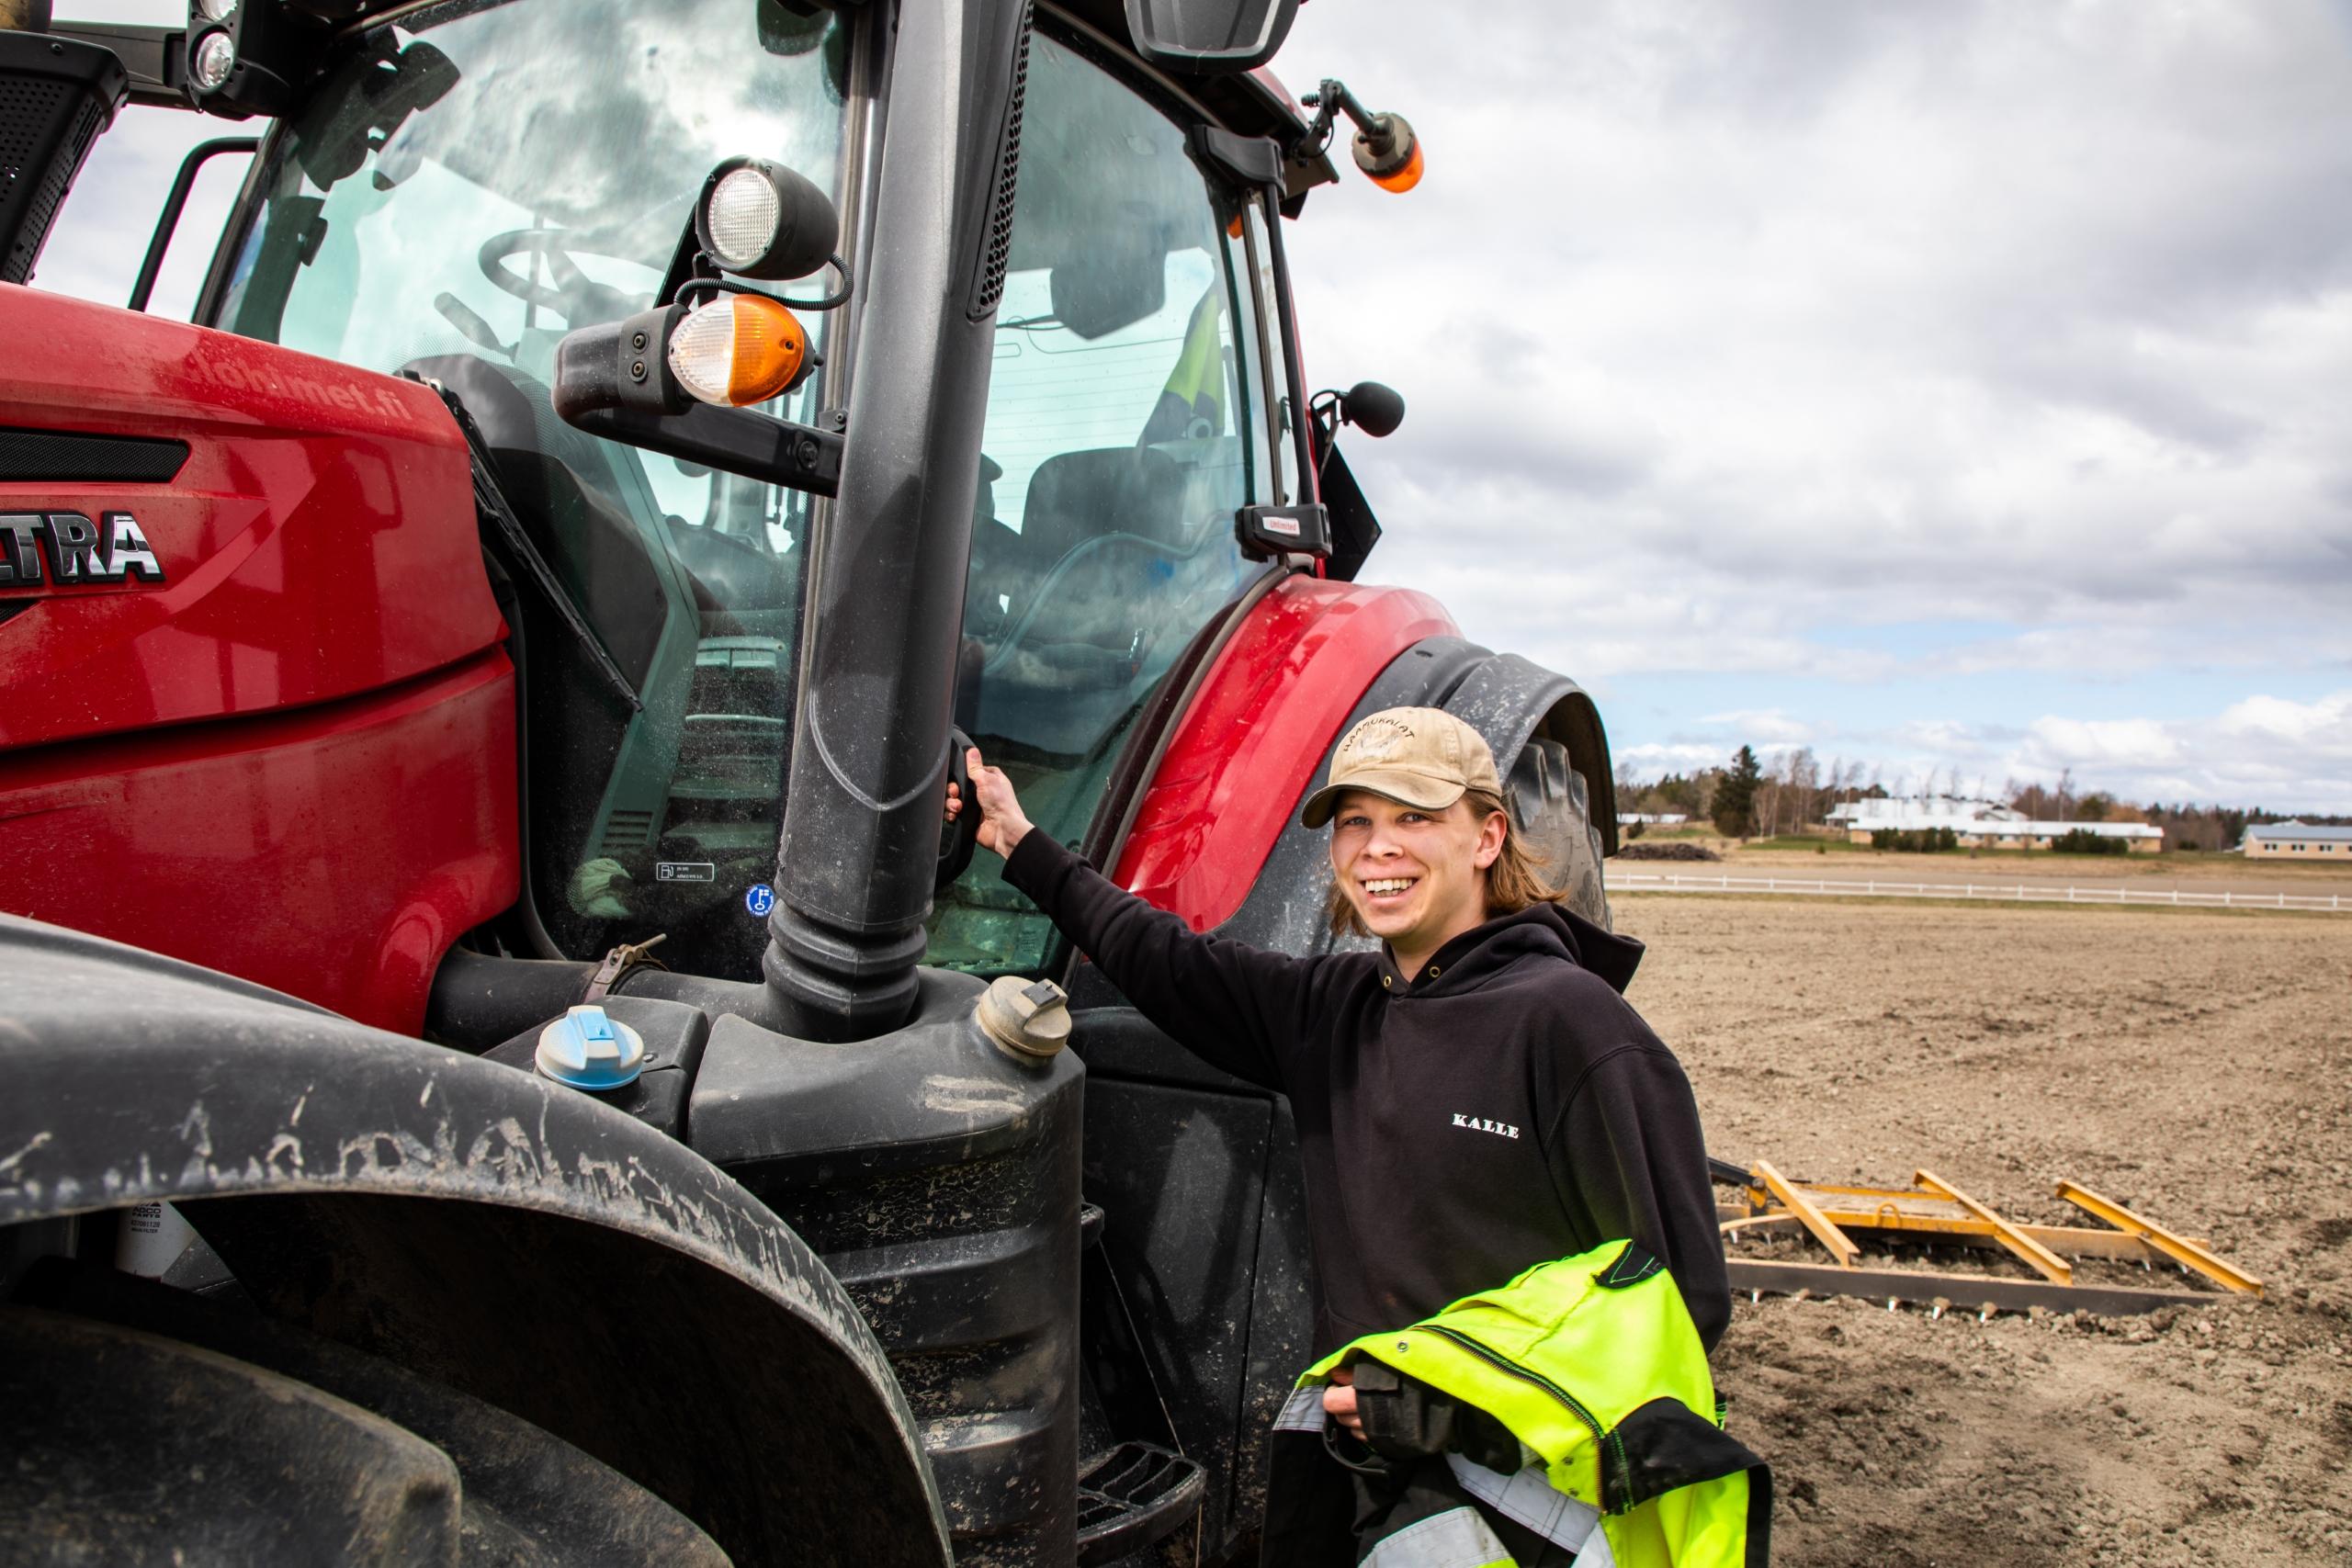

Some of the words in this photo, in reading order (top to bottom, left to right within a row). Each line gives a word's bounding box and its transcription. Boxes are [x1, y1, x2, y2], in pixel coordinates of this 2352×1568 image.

[0, 514, 161, 582] TRA
[1343, 716, 1415, 752] HAAMUKALAT
[1452, 1112, 1520, 1139] KALLE
